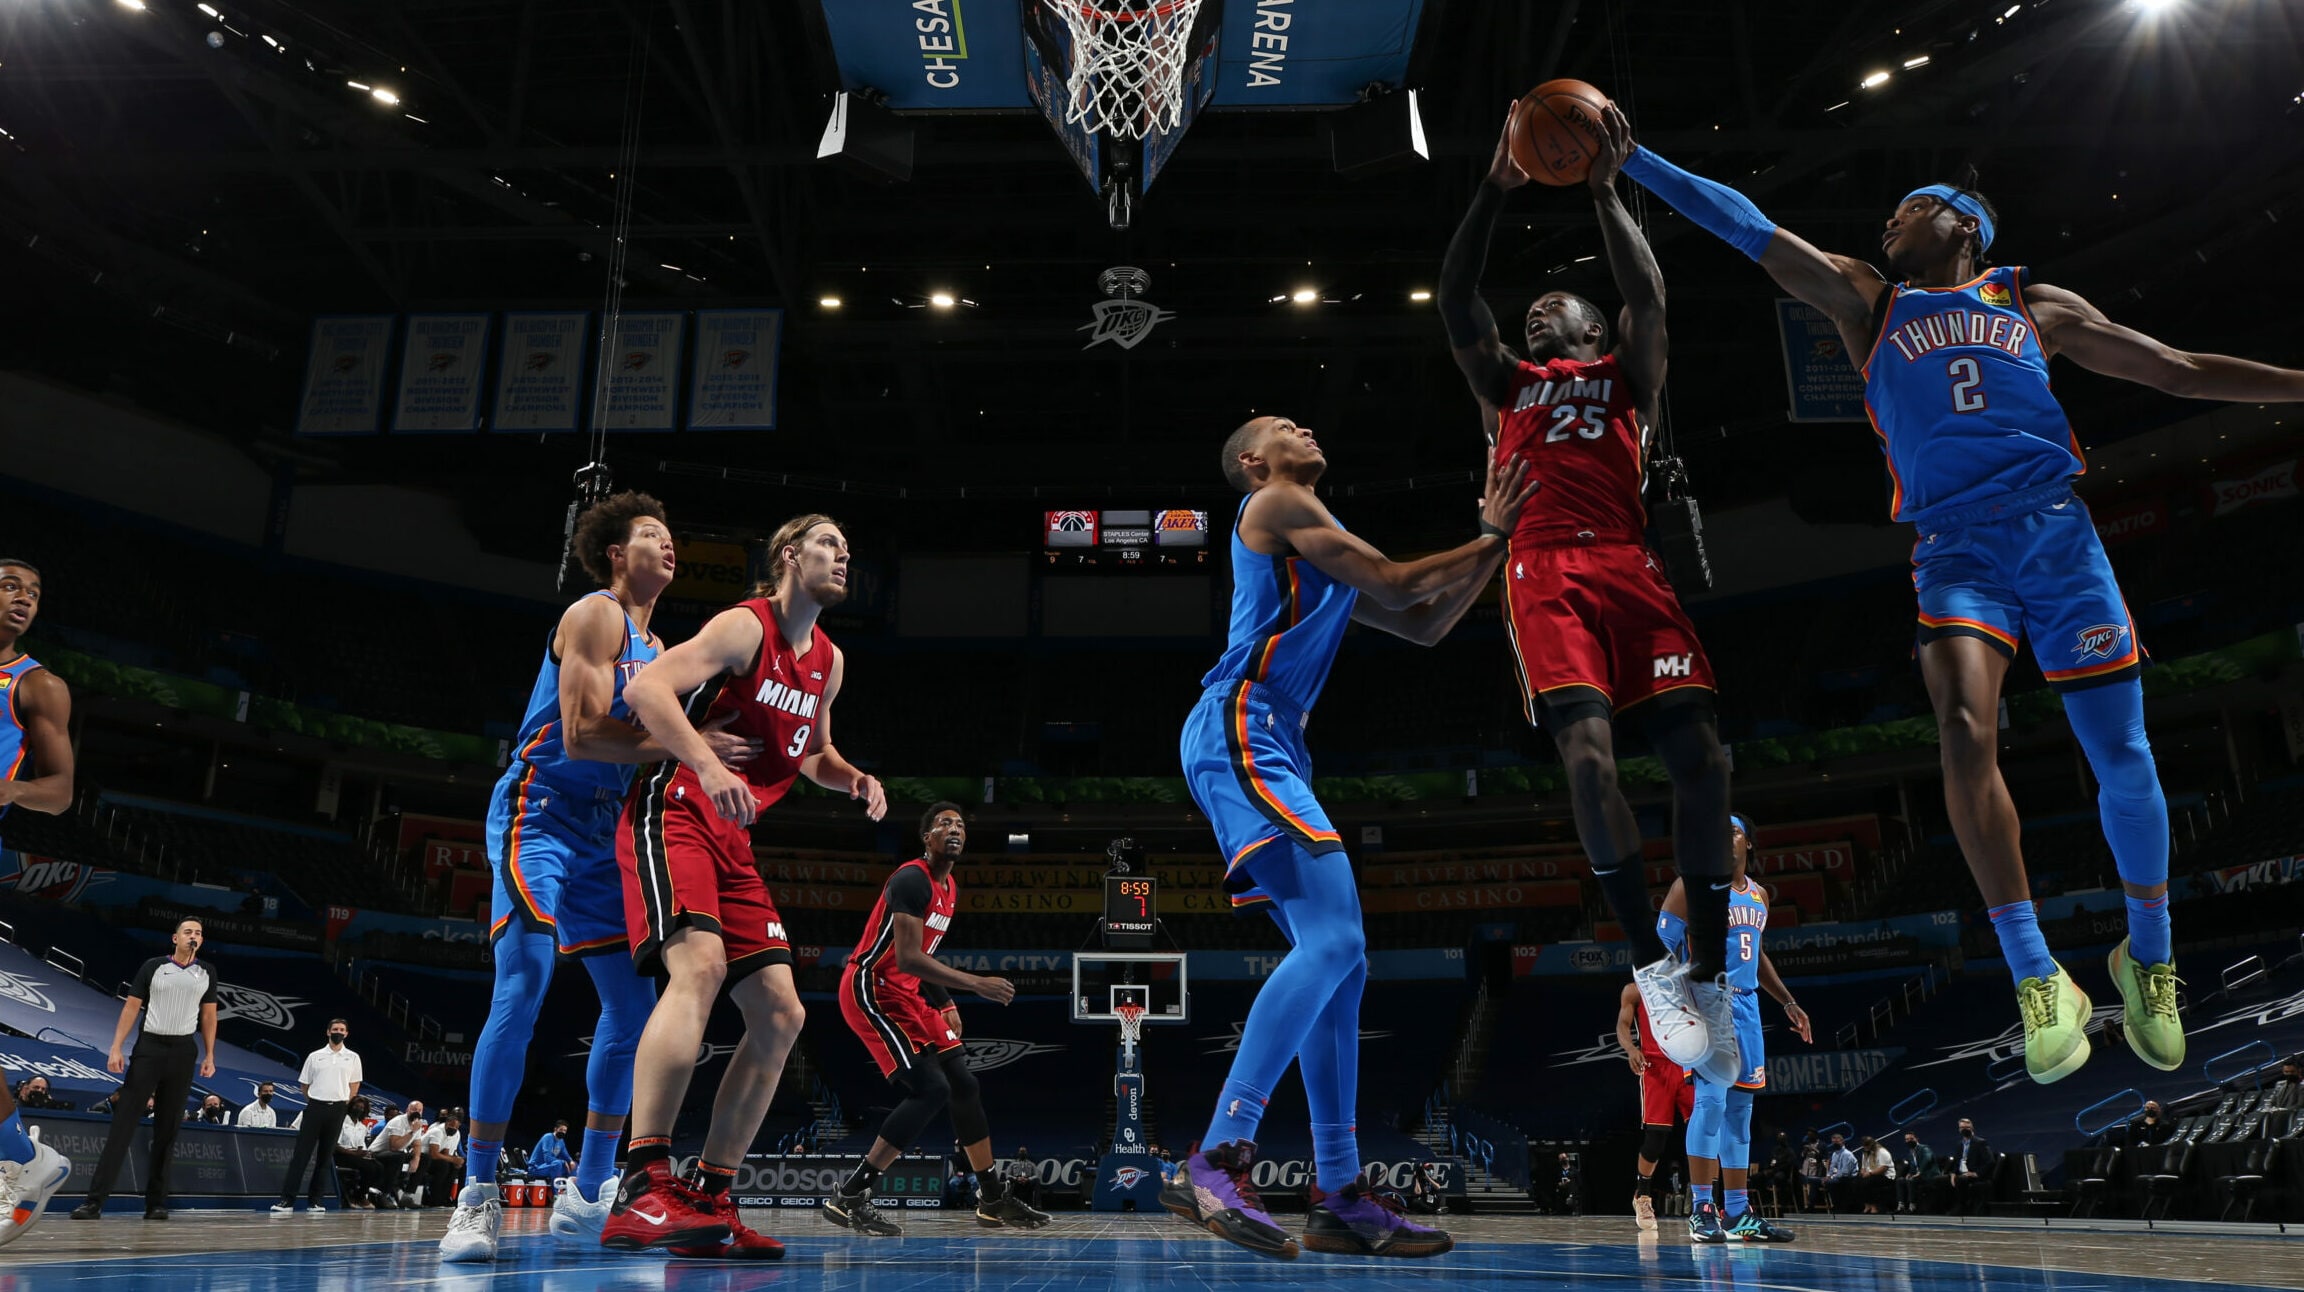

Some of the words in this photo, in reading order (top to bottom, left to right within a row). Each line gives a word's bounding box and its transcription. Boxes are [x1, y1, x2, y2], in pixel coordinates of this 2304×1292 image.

[1888, 311, 2029, 362] THUNDER
[1806, 363, 1855, 373] 2011-201
[1798, 384, 1864, 393] CONFERENC
[1948, 356, 1986, 414] 2
[1514, 376, 1613, 413] MIAMI
[1803, 393, 1863, 401] CHAMPION
[1545, 405, 1607, 443] 25
[2222, 471, 2289, 505] SONIC
[1122, 551, 1140, 559] 8:59
[755, 678, 819, 719] MIAMI
[787, 724, 812, 759] 9
[14, 861, 79, 893] OKC
[962, 869, 1101, 888] IVERWIND
[1392, 861, 1559, 884] RIVERWIND
[1121, 881, 1150, 895] 8:59
[262, 897, 279, 911] 18
[970, 894, 1073, 910] CASINO
[1416, 886, 1523, 908] CASINO
[330, 907, 350, 920] 119
[1132, 895, 1147, 919] 7
[1121, 922, 1153, 931] TISSOT
[1931, 912, 1958, 926] 102
[799, 945, 821, 957] 120
[1514, 946, 1537, 957] 102
[1740, 932, 1752, 961] 5
[1443, 949, 1464, 960] 101
[1579, 951, 1603, 963] FOX
[1000, 955, 1062, 972] CITY
[1128, 1087, 1138, 1121] devon
[1115, 1142, 1146, 1155] Health
[739, 1197, 773, 1206] GEICO
[780, 1197, 815, 1206] GEICO
[874, 1198, 899, 1206] EICO
[906, 1199, 941, 1207] GEICO
